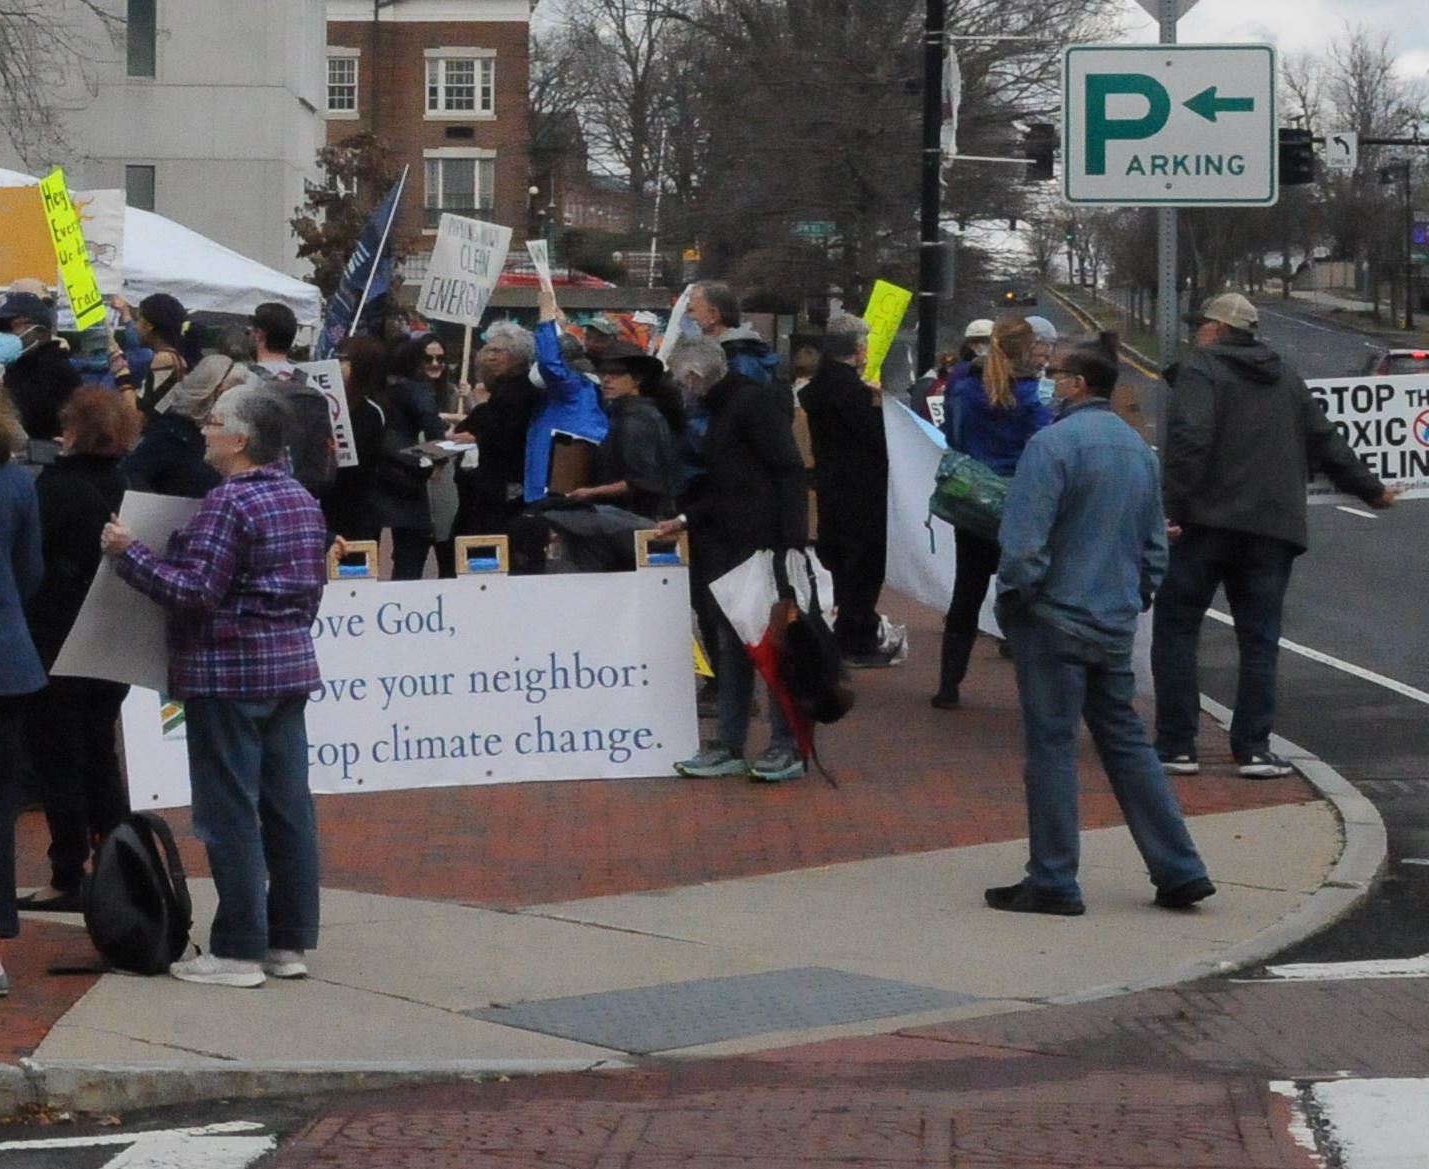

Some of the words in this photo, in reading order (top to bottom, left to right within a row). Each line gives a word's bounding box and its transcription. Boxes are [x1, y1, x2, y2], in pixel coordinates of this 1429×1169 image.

[41, 182, 69, 213] Hey
[1307, 384, 1395, 415] STOP
[376, 595, 457, 638] God,
[378, 671, 455, 711] your
[468, 651, 649, 705] neighbor:
[371, 723, 503, 765] climate
[514, 714, 663, 764] change.
